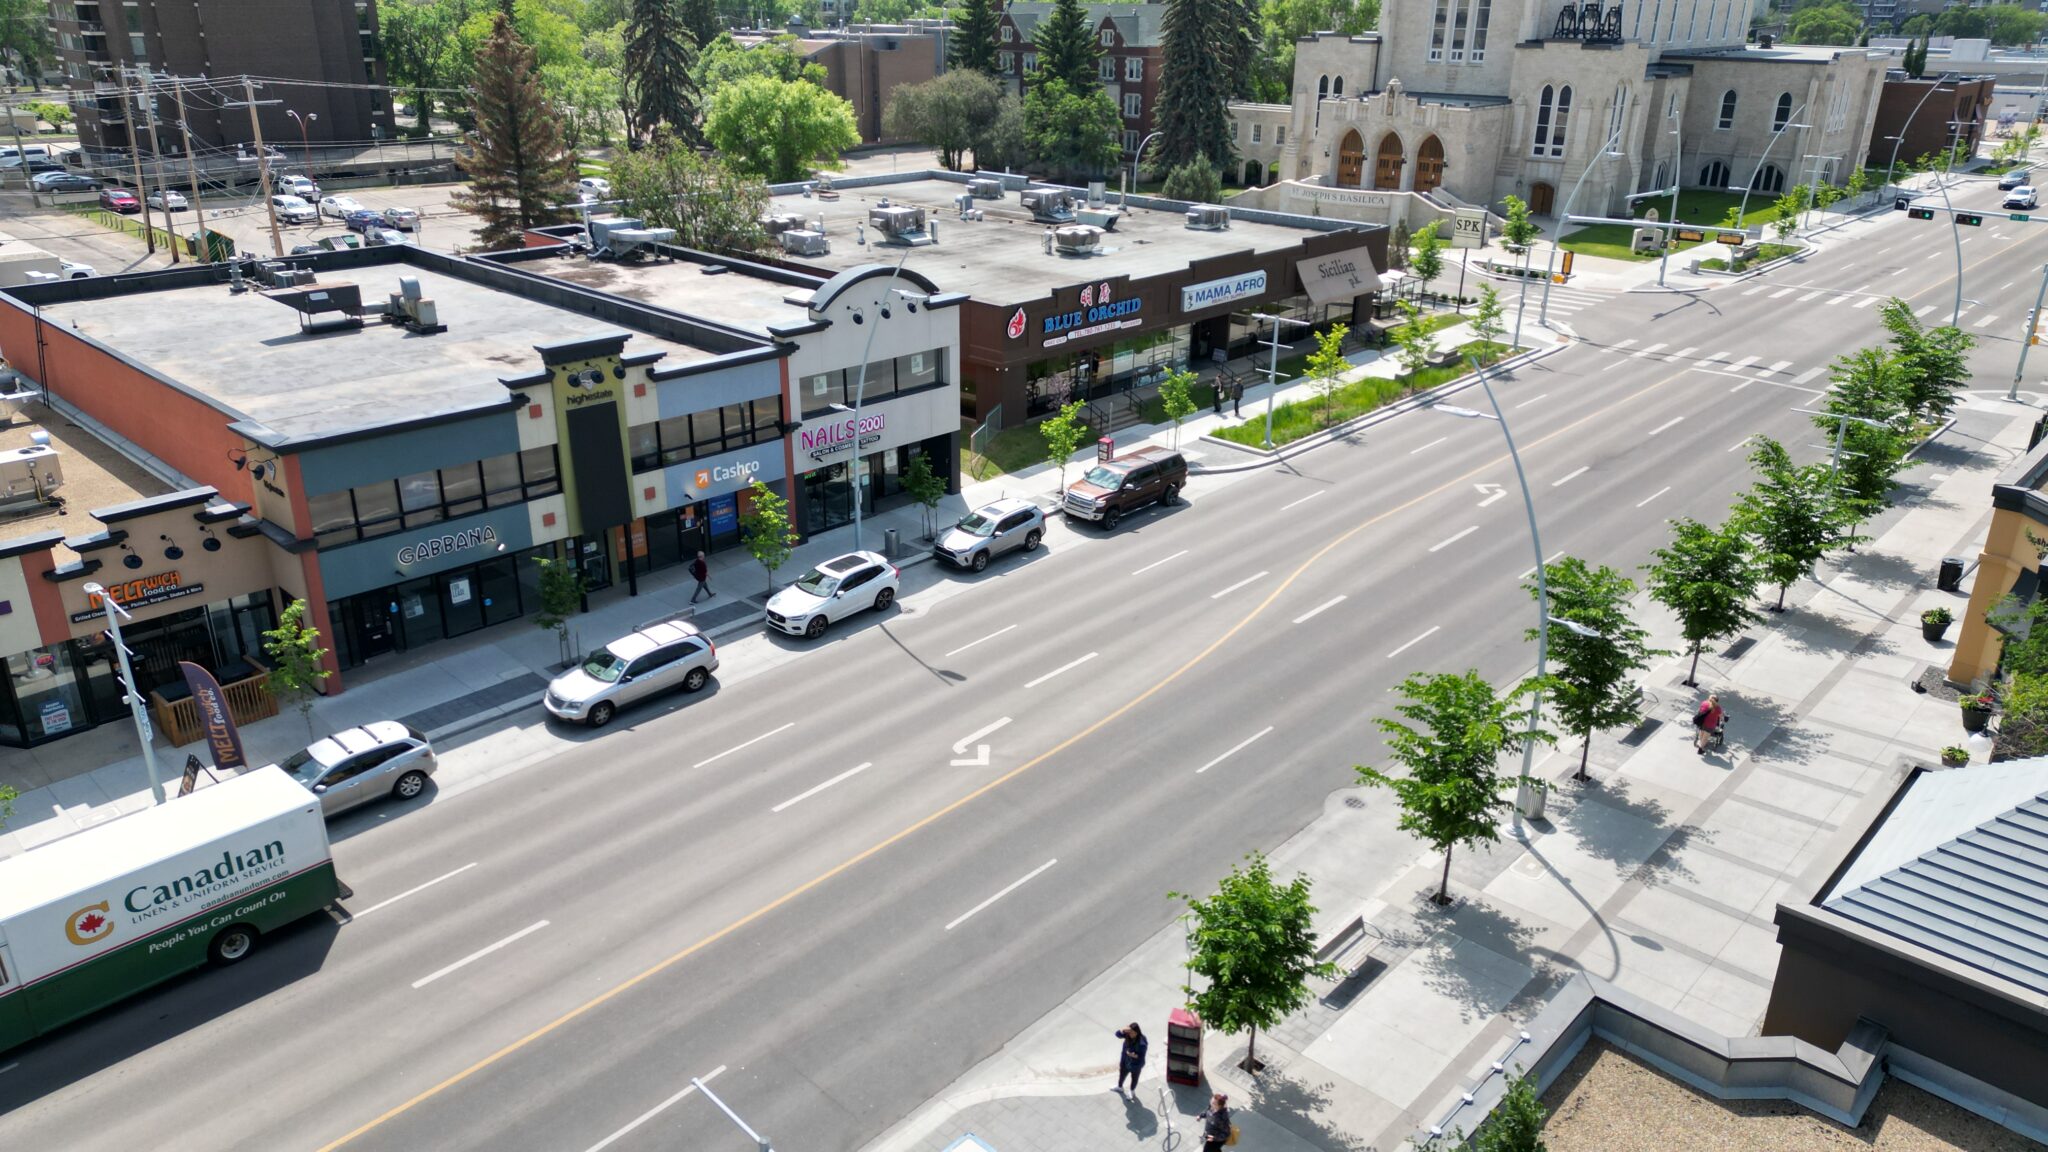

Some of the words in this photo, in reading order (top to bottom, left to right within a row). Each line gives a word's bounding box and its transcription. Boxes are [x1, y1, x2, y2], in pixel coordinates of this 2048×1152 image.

[1340, 193, 1385, 204] BASILICA
[1455, 219, 1480, 232] SPK
[1318, 258, 1356, 278] Sicilian
[1195, 284, 1231, 303] MAMA
[1235, 276, 1265, 293] AFRO
[1044, 311, 1083, 333] BLUE
[1088, 297, 1142, 323] ORCHID
[566, 390, 613, 405] highestate
[801, 419, 855, 450] NAILS
[858, 413, 885, 435] 2001
[812, 447, 829, 457] SALON
[713, 460, 760, 482] Cashco
[397, 525, 497, 565] GABBANA
[143, 587, 164, 597] food
[213, 702, 225, 724] food
[124, 840, 285, 913] Canadian
[132, 904, 168, 924] LINEN
[184, 877, 240, 903] UNIFORM
[243, 857, 286, 878] SERVICE
[200, 869, 289, 910] canadianuniform.com
[149, 931, 185, 954] People
[187, 922, 208, 936] You
[210, 913, 232, 927] Can
[234, 898, 267, 917] Count
[269, 890, 286, 903] On
